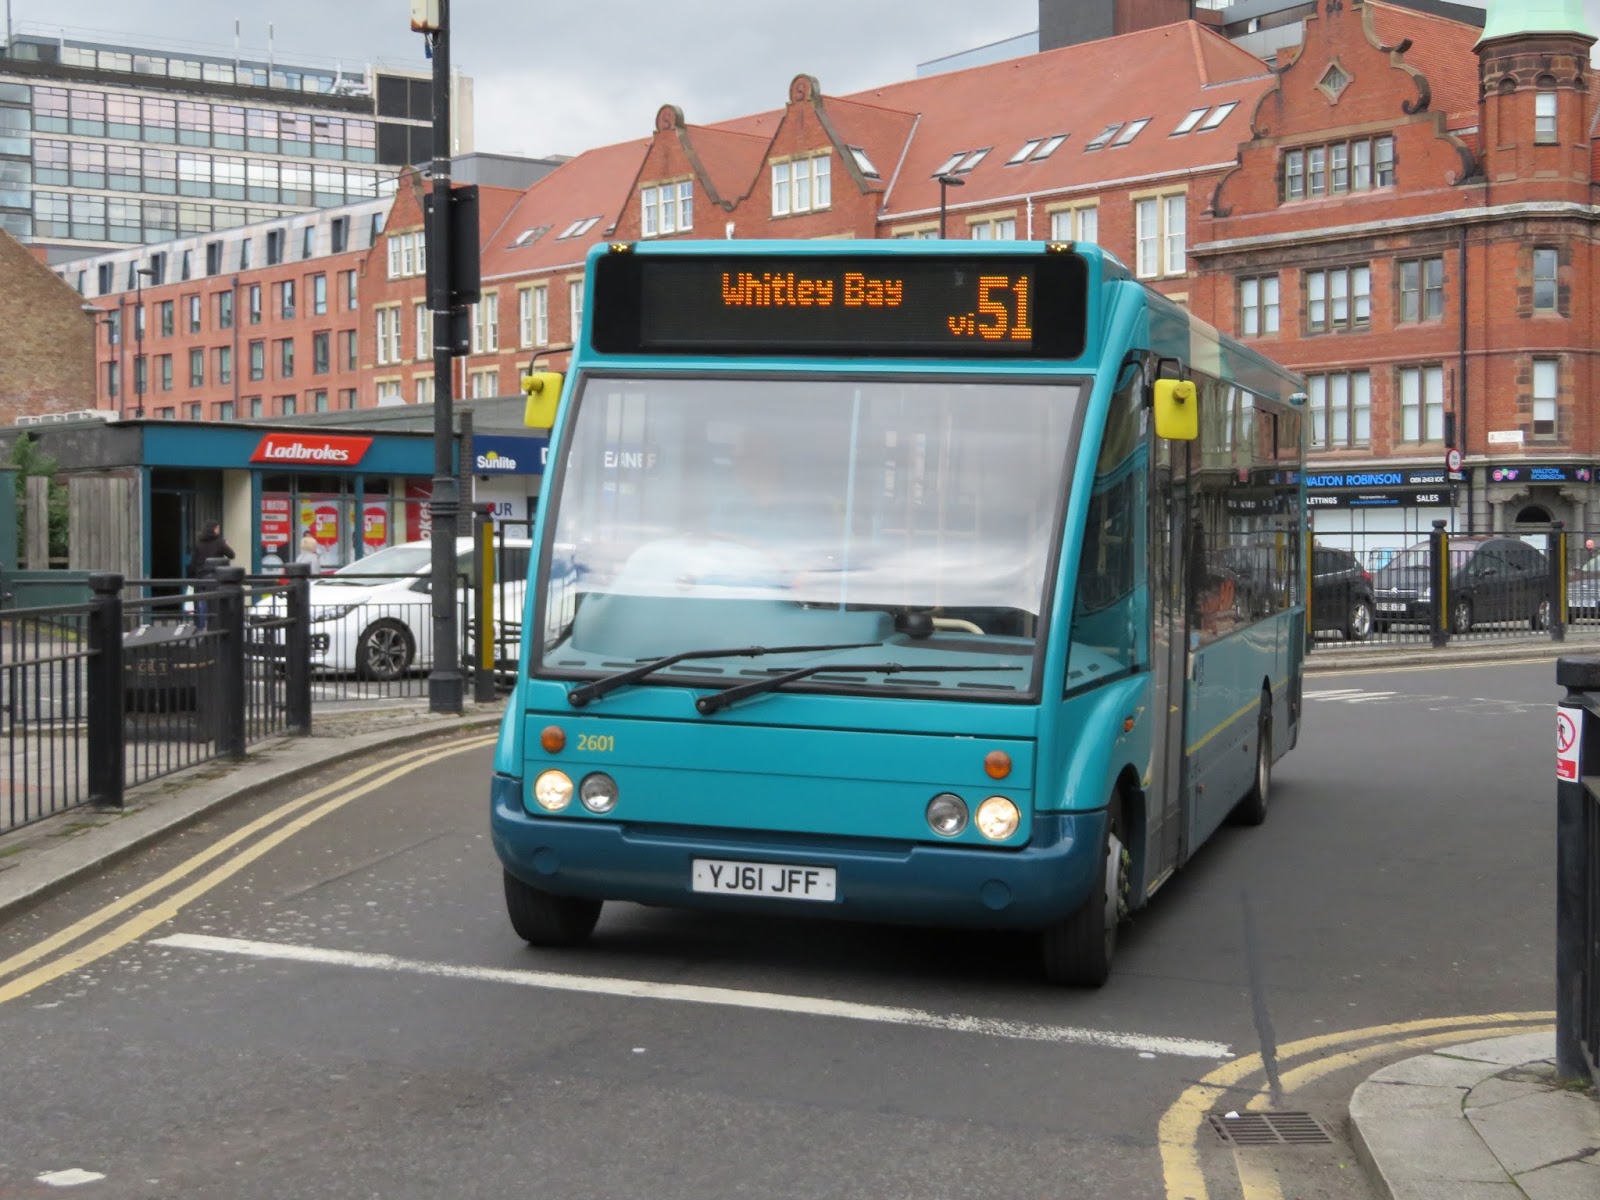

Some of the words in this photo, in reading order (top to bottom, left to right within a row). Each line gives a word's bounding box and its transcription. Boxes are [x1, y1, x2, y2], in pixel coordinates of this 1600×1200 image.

[722, 273, 833, 306] Whitley
[844, 273, 902, 306] Bay
[264, 441, 349, 461] Ladbrokes
[476, 455, 516, 469] Sunlite
[1346, 474, 1402, 485] ROBINSON
[1416, 494, 1439, 502] SALES
[577, 734, 615, 751] 2601
[709, 864, 763, 891] YJ61
[771, 868, 819, 894] JFF
